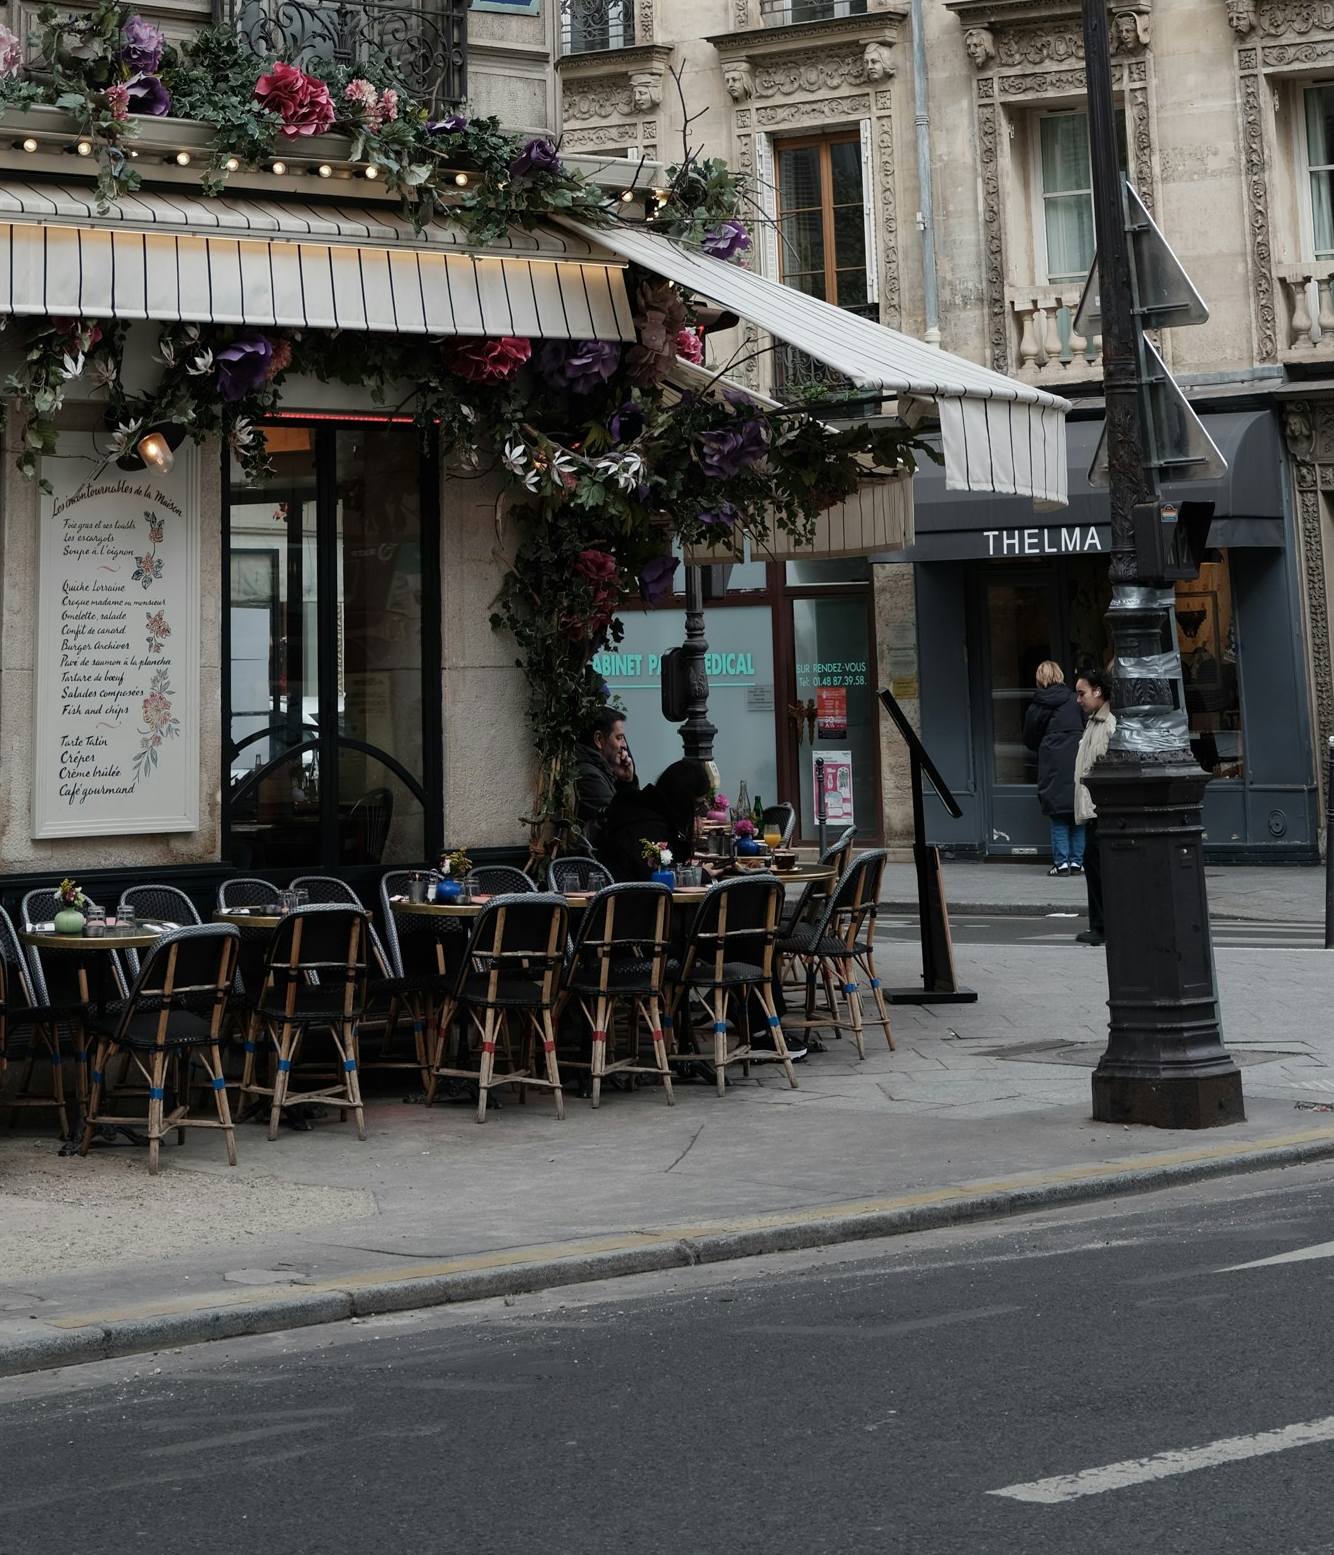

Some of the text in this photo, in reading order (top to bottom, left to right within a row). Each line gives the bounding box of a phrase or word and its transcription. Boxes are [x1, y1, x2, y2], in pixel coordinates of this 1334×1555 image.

[51, 479, 183, 519] Les incontournables de la Maison
[62, 518, 78, 530] Foie
[77, 521, 93, 534] gras
[94, 519, 102, 530] et
[63, 532, 114, 546] Les escargots
[983, 526, 1102, 555] THELMA
[63, 544, 134, 561] Soupe à l'oignon
[62, 579, 126, 594] Quiche Lorraine
[61, 596, 89, 609] Croque
[90, 597, 123, 606] madame
[134, 598, 166, 606] monsieur
[100, 611, 127, 620] salade
[61, 624, 126, 641] Confit de canard
[61, 639, 130, 655] Burger Archives
[60, 654, 78, 667] Pavé
[80, 657, 89, 666] de
[123, 657, 129, 665] à
[130, 655, 137, 665] la
[138, 656, 171, 670] plancha
[796, 662, 867, 674] SUR RENDEZ-VOUS
[61, 669, 125, 687] Tartare de bœuf
[61, 686, 144, 702] Salades composées
[62, 704, 129, 720] Fish and chips
[60, 735, 108, 747] Tarte Tatin
[60, 751, 95, 768] Crêpes
[59, 765, 122, 780] Crème brûlée
[59, 782, 136, 806] Café gourmand
